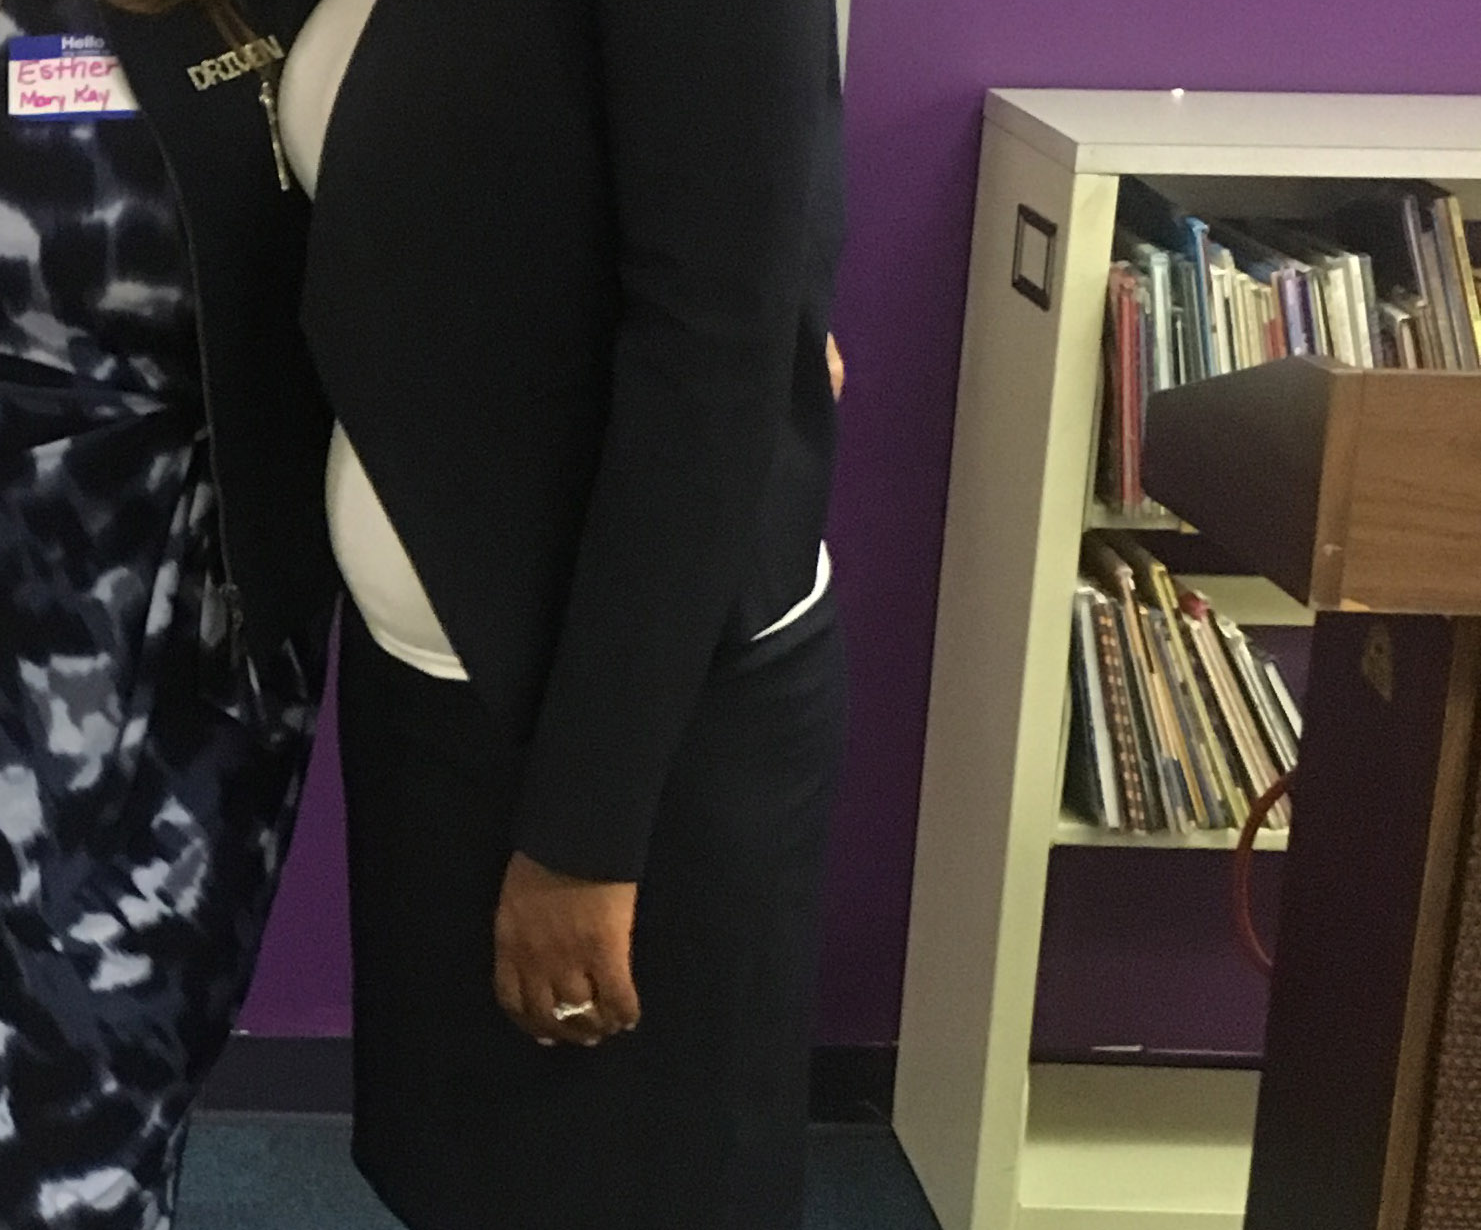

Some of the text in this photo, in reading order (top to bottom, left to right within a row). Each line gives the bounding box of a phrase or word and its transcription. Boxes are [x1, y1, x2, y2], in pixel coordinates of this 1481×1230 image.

[61, 35, 105, 50] Hello
[17, 57, 119, 85] Esther
[20, 84, 111, 112] Mary Kay
